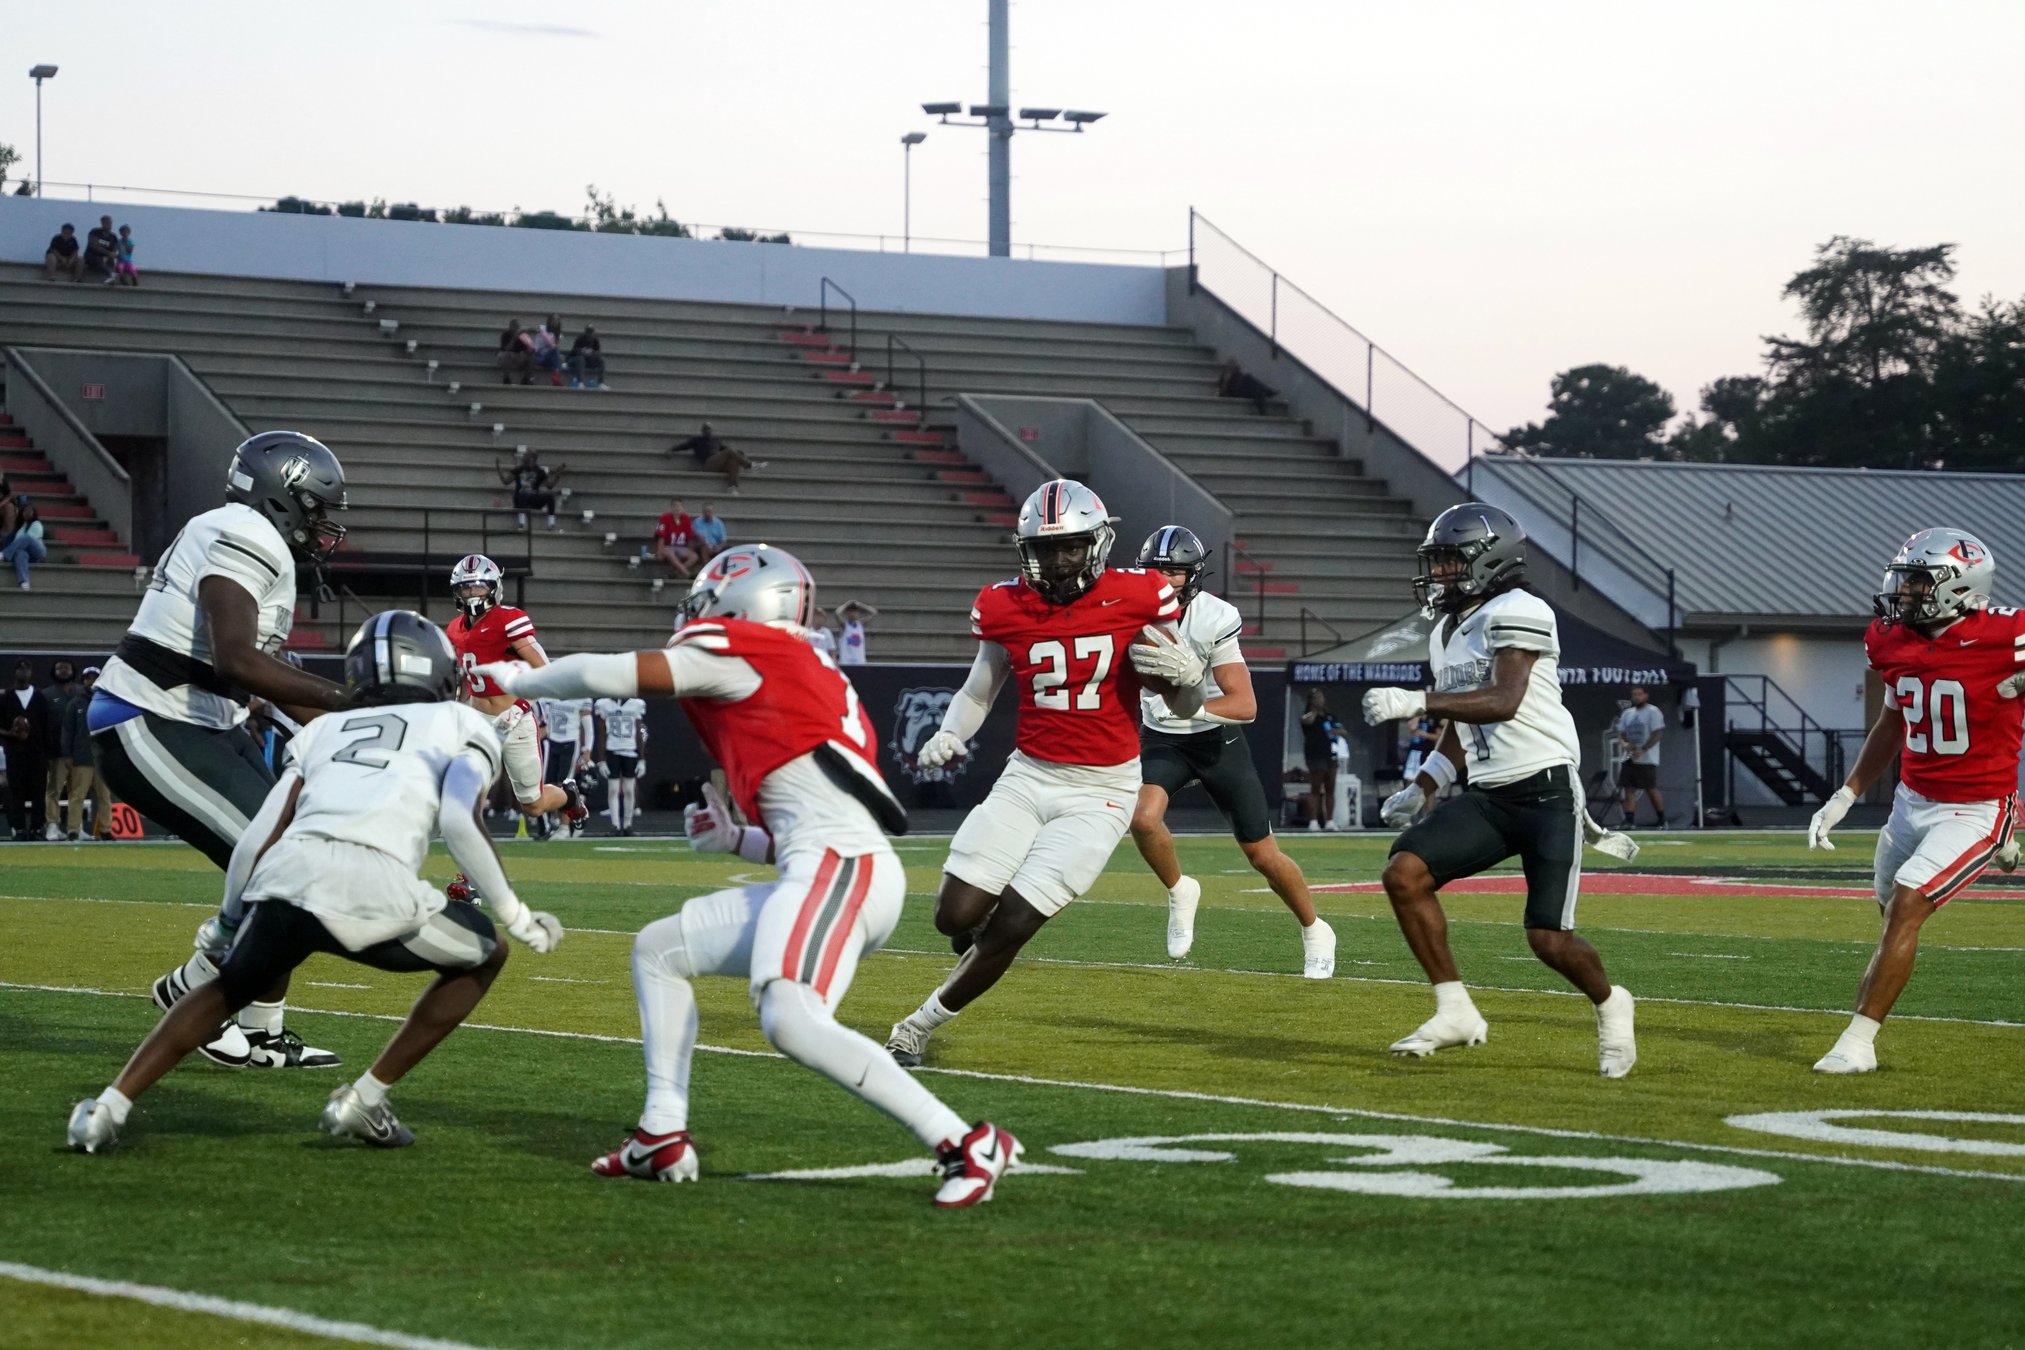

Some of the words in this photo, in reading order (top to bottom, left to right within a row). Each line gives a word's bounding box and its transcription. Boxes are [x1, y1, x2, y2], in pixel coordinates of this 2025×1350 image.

[1028, 633, 1115, 711] 27
[1294, 664, 1325, 681] HOME
[1326, 664, 1341, 681] OF
[1342, 664, 1363, 681] THE
[1364, 664, 1422, 682] WARRIORS
[330, 713, 408, 770] 2
[1896, 676, 1969, 755] 20
[111, 806, 138, 835] 50
